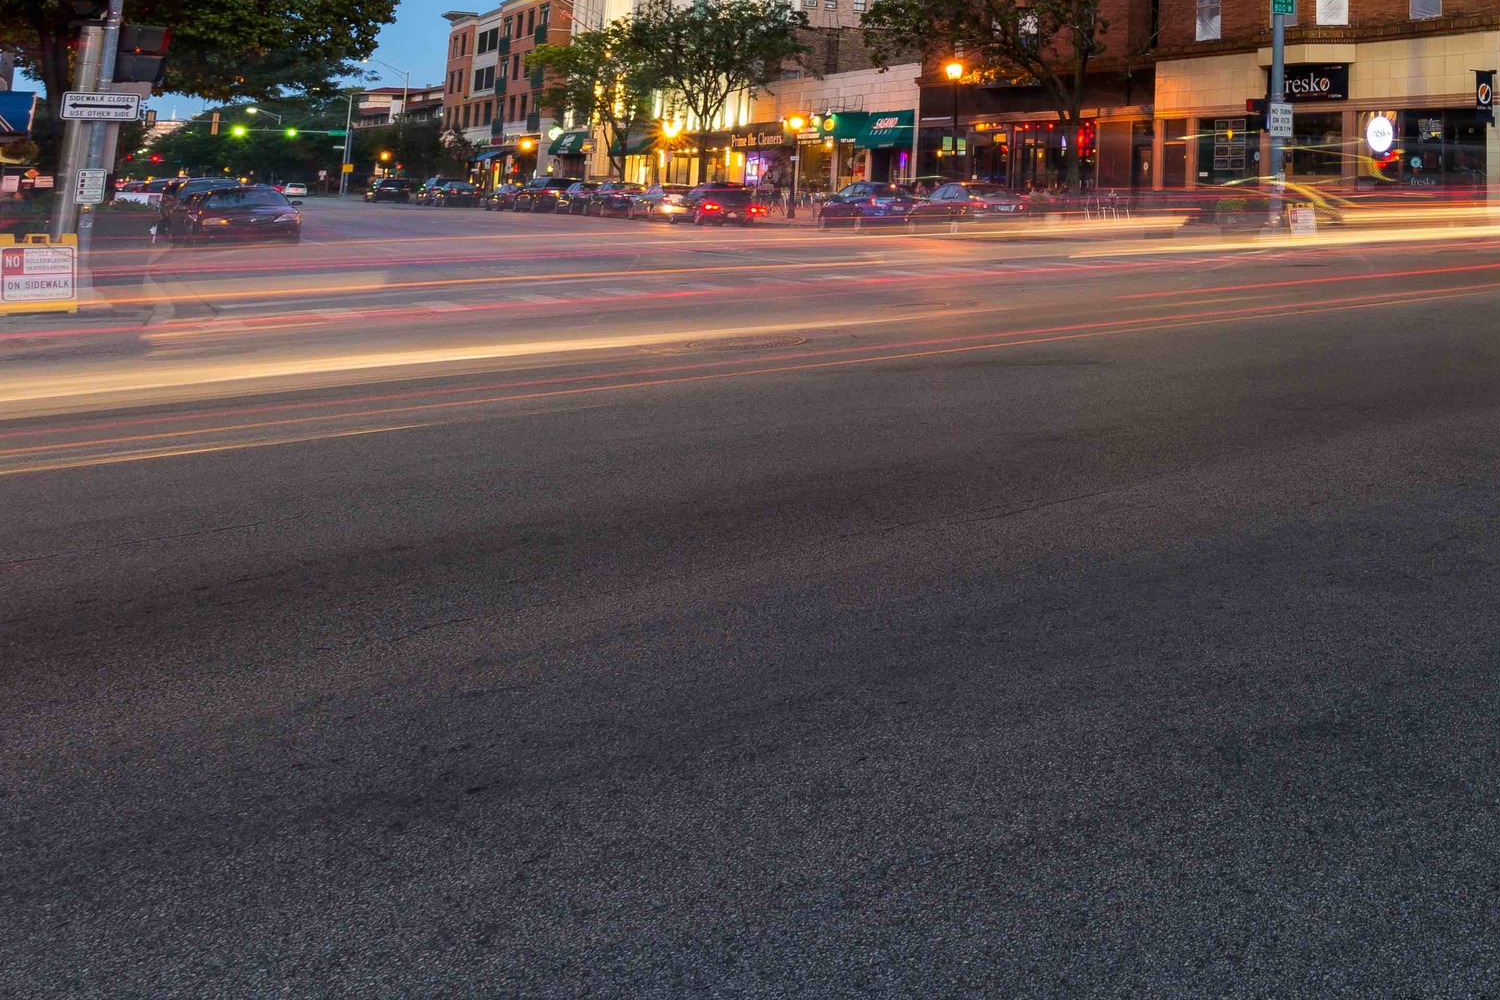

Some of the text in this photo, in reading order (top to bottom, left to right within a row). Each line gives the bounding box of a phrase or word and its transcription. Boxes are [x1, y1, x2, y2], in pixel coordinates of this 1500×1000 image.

[1274, 3, 1286, 12] 800
[731, 134, 747, 148] Prime
[758, 131, 785, 146] Cleaners
[5, 255, 20, 268] NO
[7, 280, 69, 290] ON SIDEWALK
